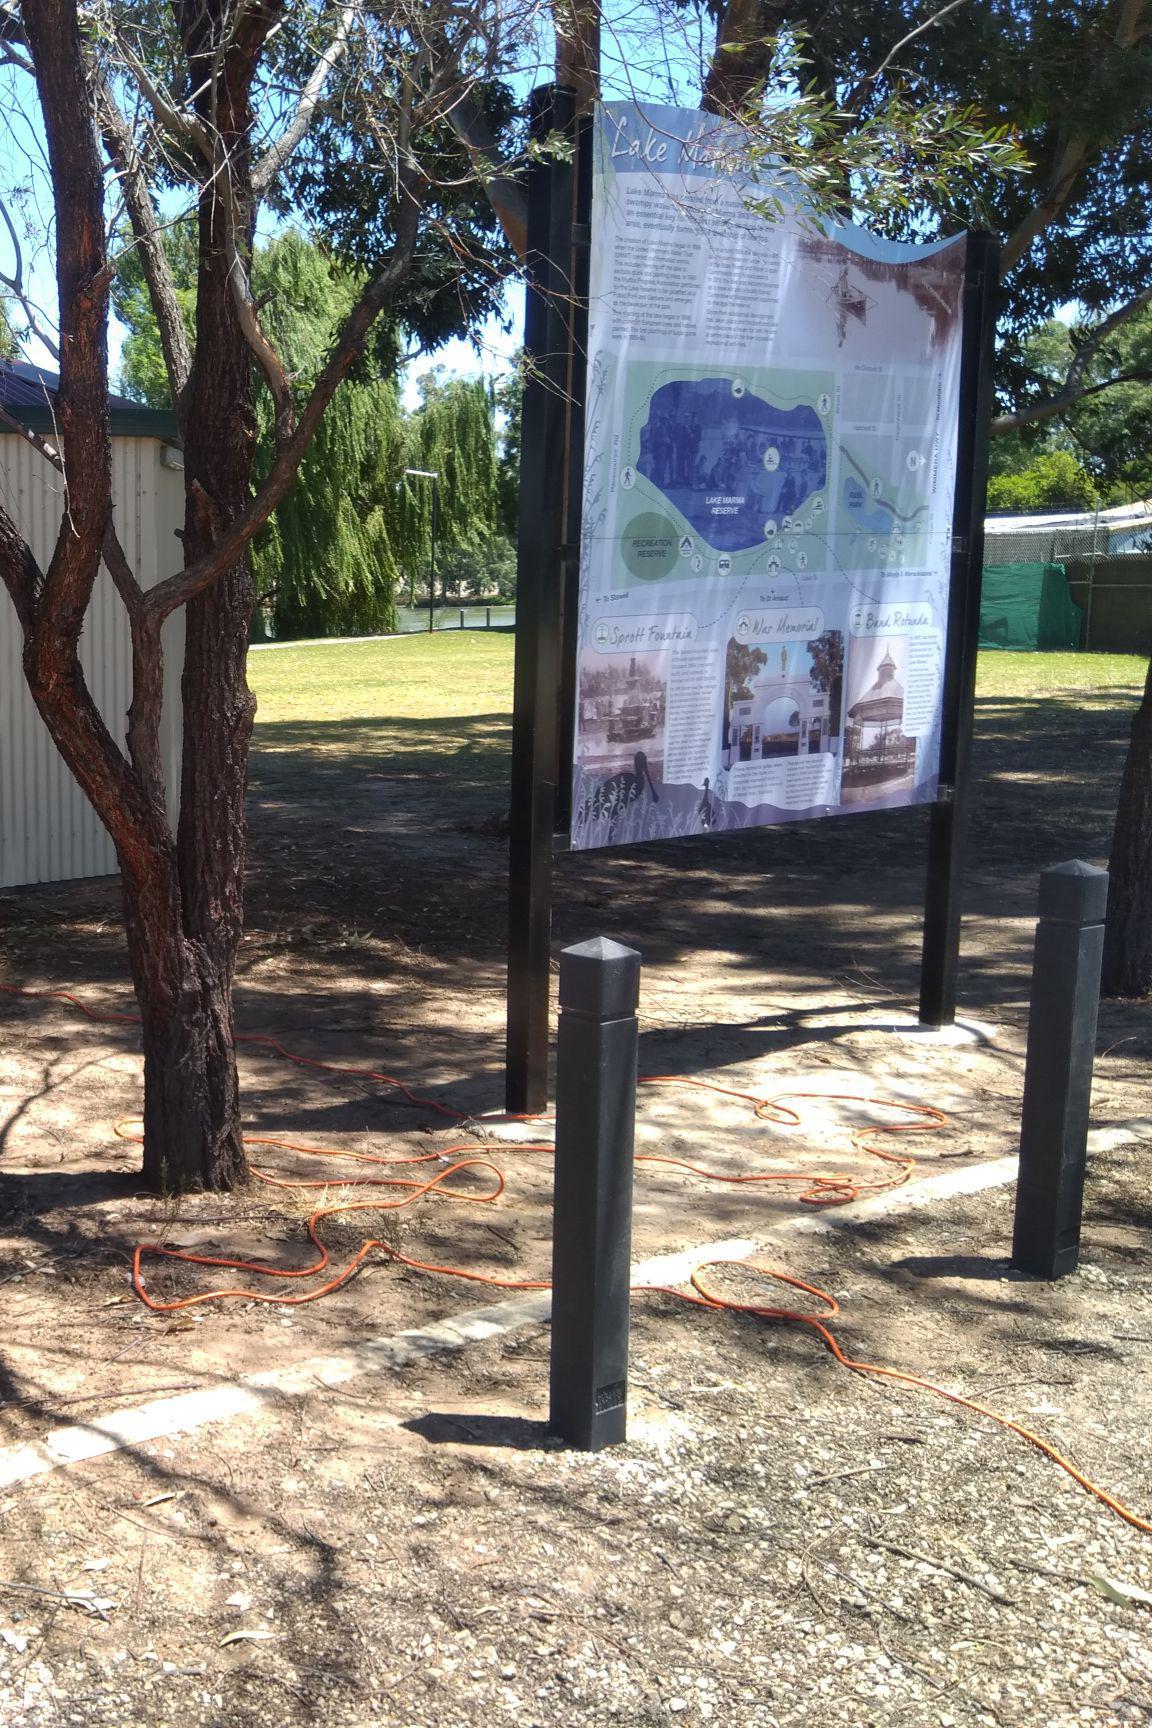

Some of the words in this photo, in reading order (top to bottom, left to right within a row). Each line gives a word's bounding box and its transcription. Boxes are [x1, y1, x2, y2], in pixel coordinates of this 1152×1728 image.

[611, 115, 668, 162] Lake
[626, 186, 644, 196] Lake
[626, 198, 653, 210] swampy
[636, 209, 665, 219] essential
[705, 496, 722, 505] LAKE
[722, 496, 746, 506] MARMA
[711, 506, 740, 515] RESERVE
[632, 538, 672, 548] RECREATION
[637, 549, 669, 559] RESERVE
[752, 617, 773, 636] War
[776, 613, 819, 635] Memorial
[866, 612, 891, 630] Band
[893, 610, 929, 628] Rotunda
[610, 625, 646, 649] Sprott
[647, 624, 693, 643] Fountain
